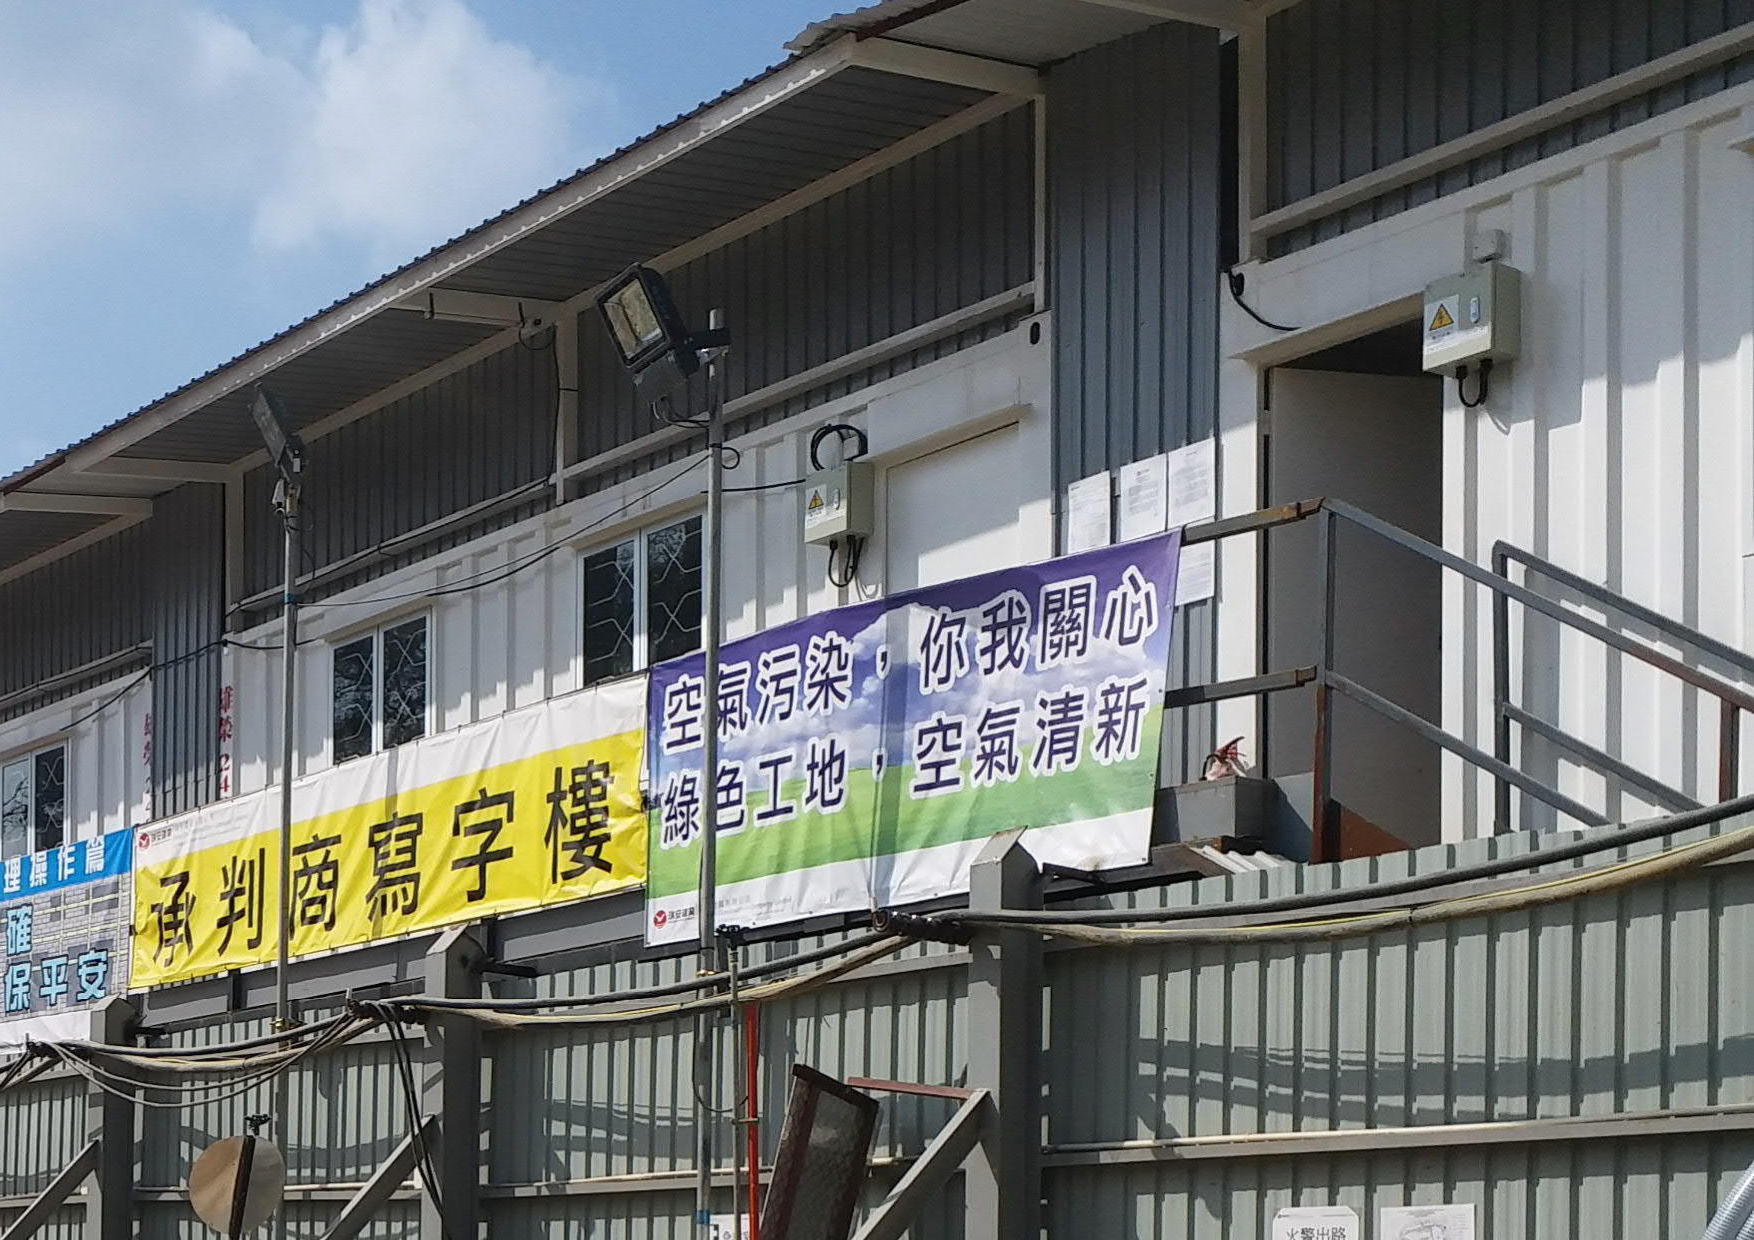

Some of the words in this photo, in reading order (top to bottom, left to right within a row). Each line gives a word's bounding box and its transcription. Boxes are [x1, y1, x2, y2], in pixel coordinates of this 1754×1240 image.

[150, 760, 615, 967] 承判商寫字樓
